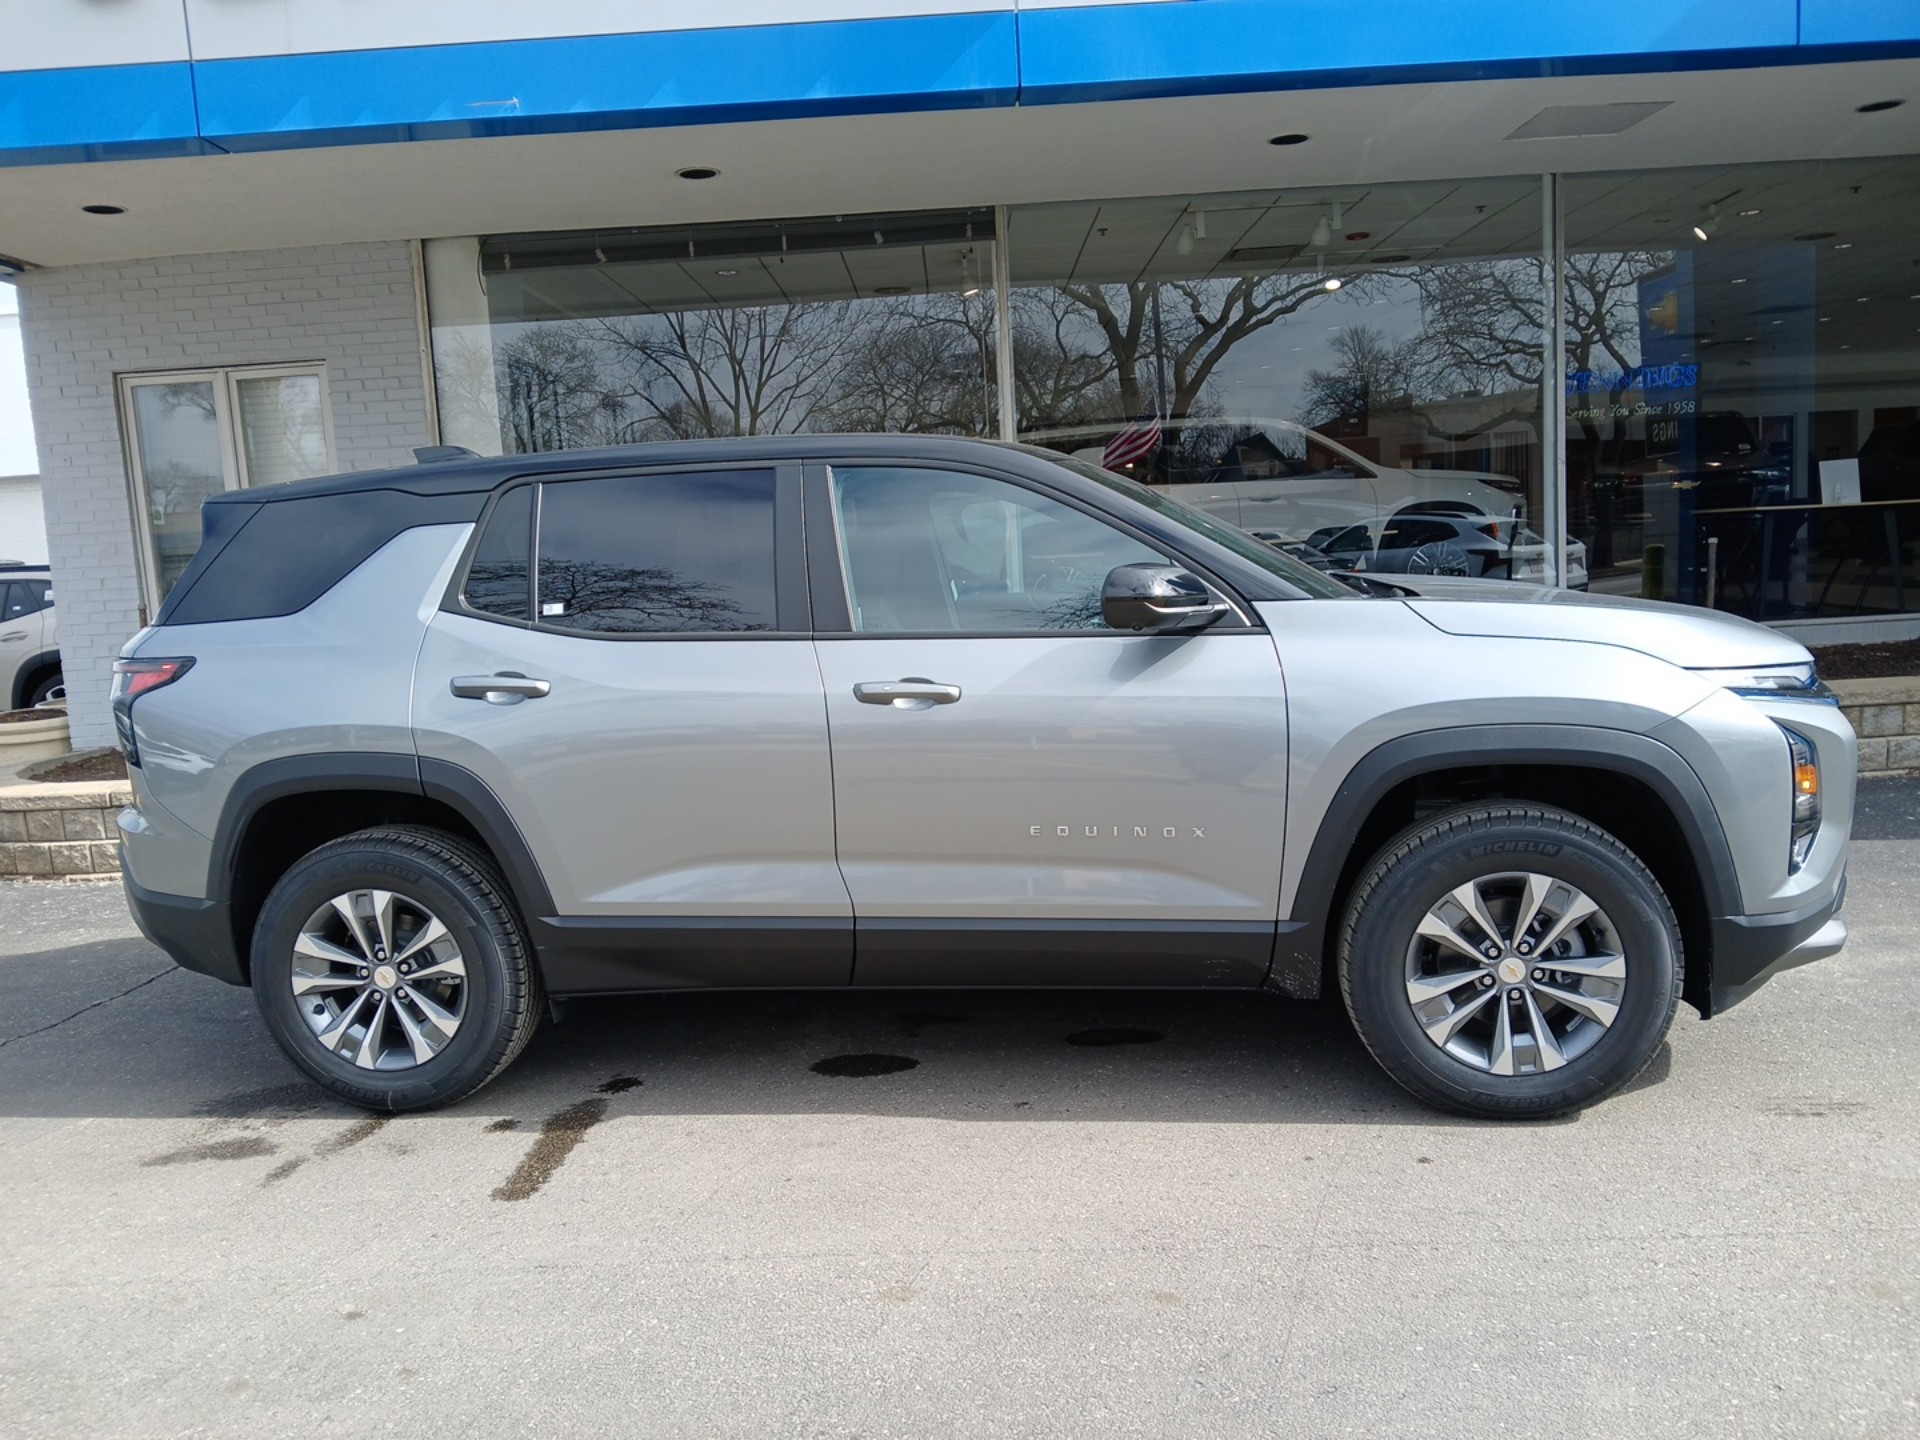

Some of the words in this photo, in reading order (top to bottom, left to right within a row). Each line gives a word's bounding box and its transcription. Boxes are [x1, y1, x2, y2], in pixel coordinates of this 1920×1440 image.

[1566, 363, 1698, 395] JENNINGS
[1566, 405, 1605, 419] Serving
[1609, 403, 1630, 417] You
[1634, 401, 1662, 416] Since
[1667, 400, 1696, 414] 1958
[1029, 825, 1206, 839] EQUINOX
[1471, 840, 1558, 857] MICHELIN
